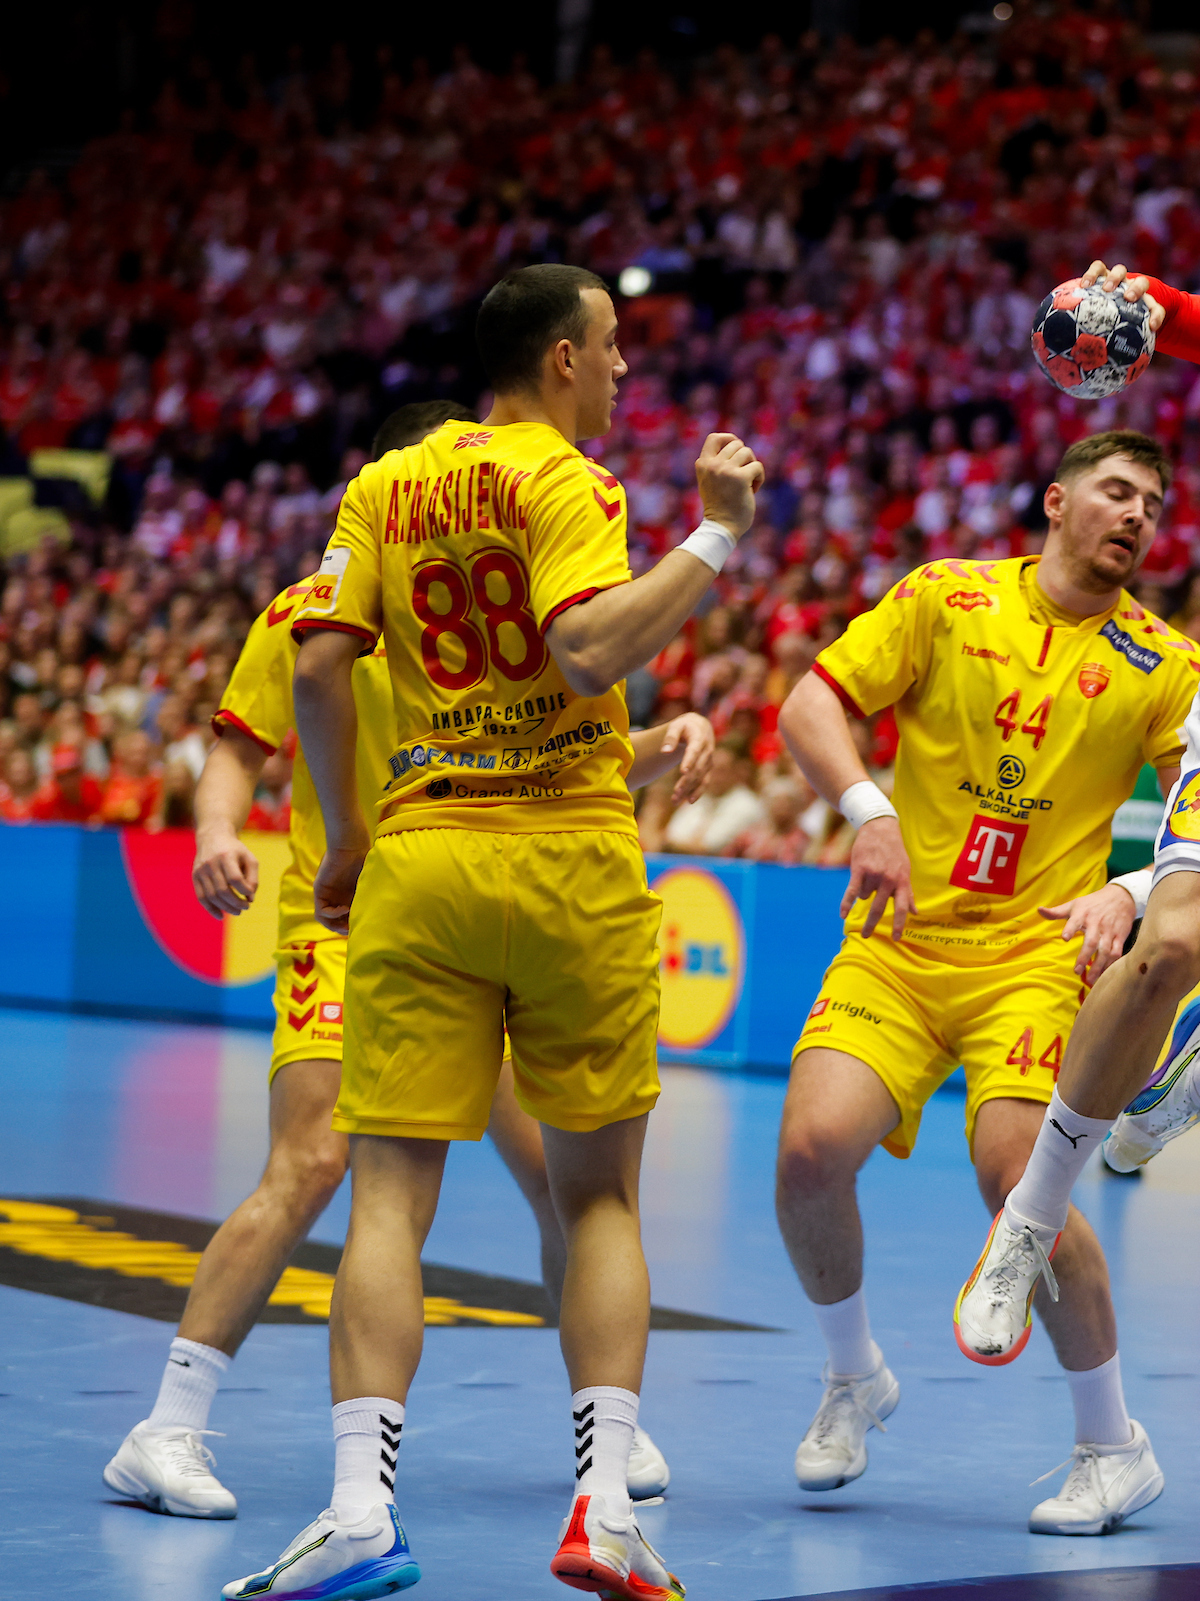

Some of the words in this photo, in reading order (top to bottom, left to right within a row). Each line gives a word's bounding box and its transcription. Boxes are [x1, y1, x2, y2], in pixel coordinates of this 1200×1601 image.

[411, 546, 550, 691] 88
[482, 724, 518, 737] 1922
[995, 687, 1052, 750] 44
[456, 785, 513, 799] Grand
[519, 785, 563, 799] Auto
[957, 781, 1053, 810] ALKALOID
[979, 799, 1030, 819] SKOPJE
[832, 1001, 882, 1024] triglav
[1006, 1026, 1062, 1082] 44
